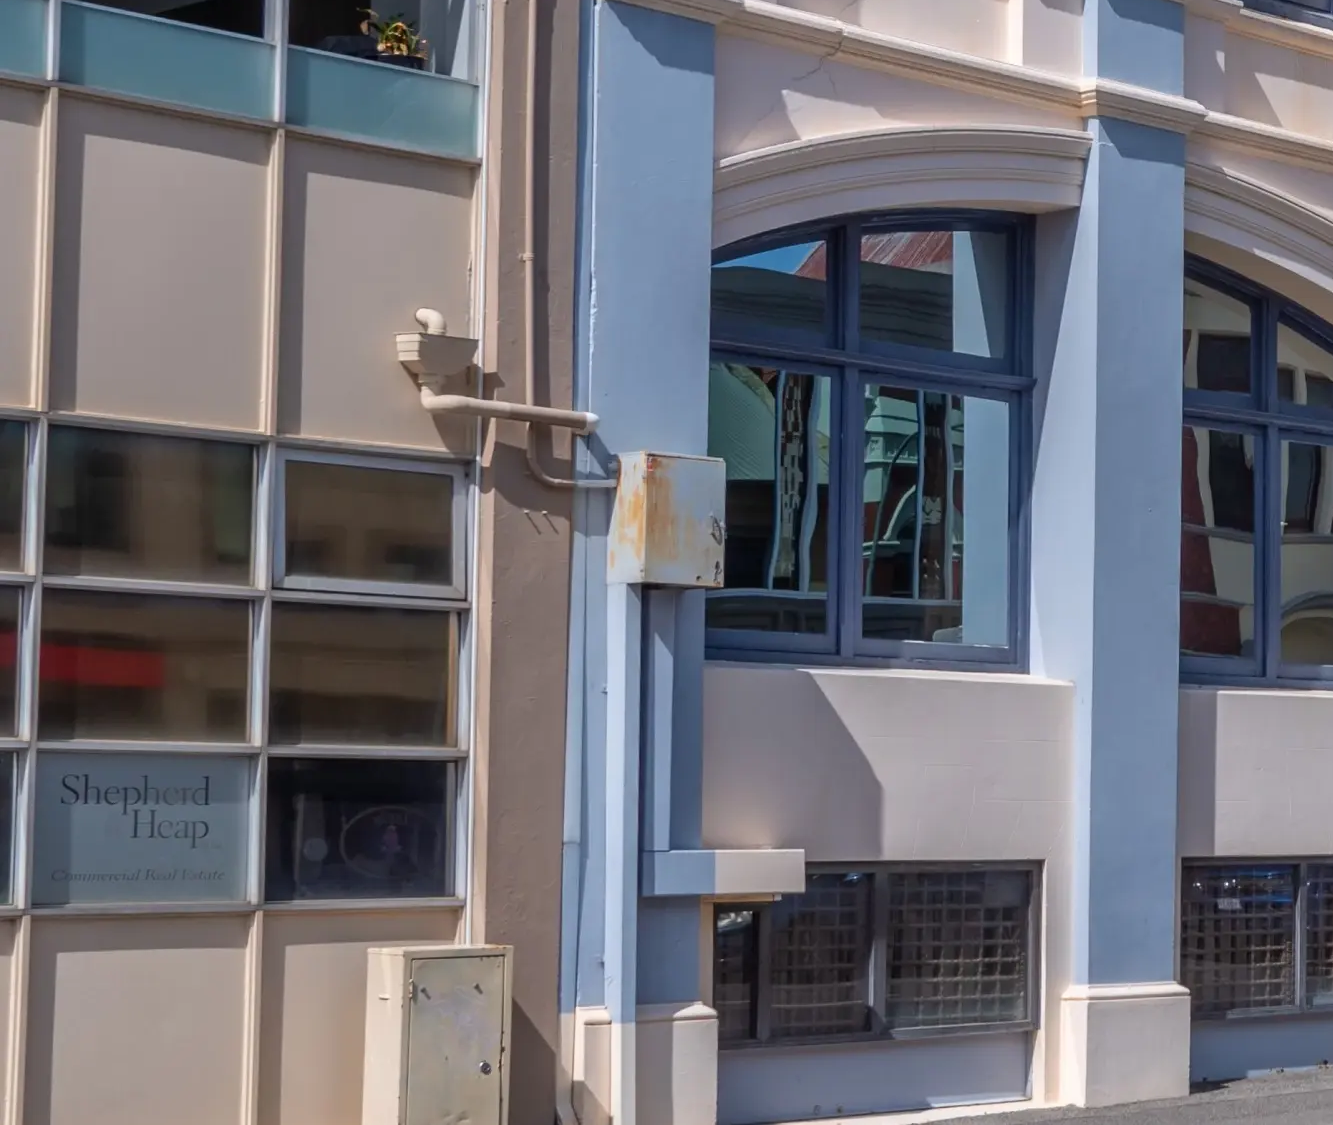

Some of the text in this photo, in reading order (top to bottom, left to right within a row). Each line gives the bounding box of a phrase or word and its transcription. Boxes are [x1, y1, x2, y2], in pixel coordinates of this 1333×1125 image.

[60, 774, 211, 816] Shepherd
[130, 809, 210, 850] Heap
[51, 868, 141, 883] Commercial
[144, 868, 178, 882] Real
